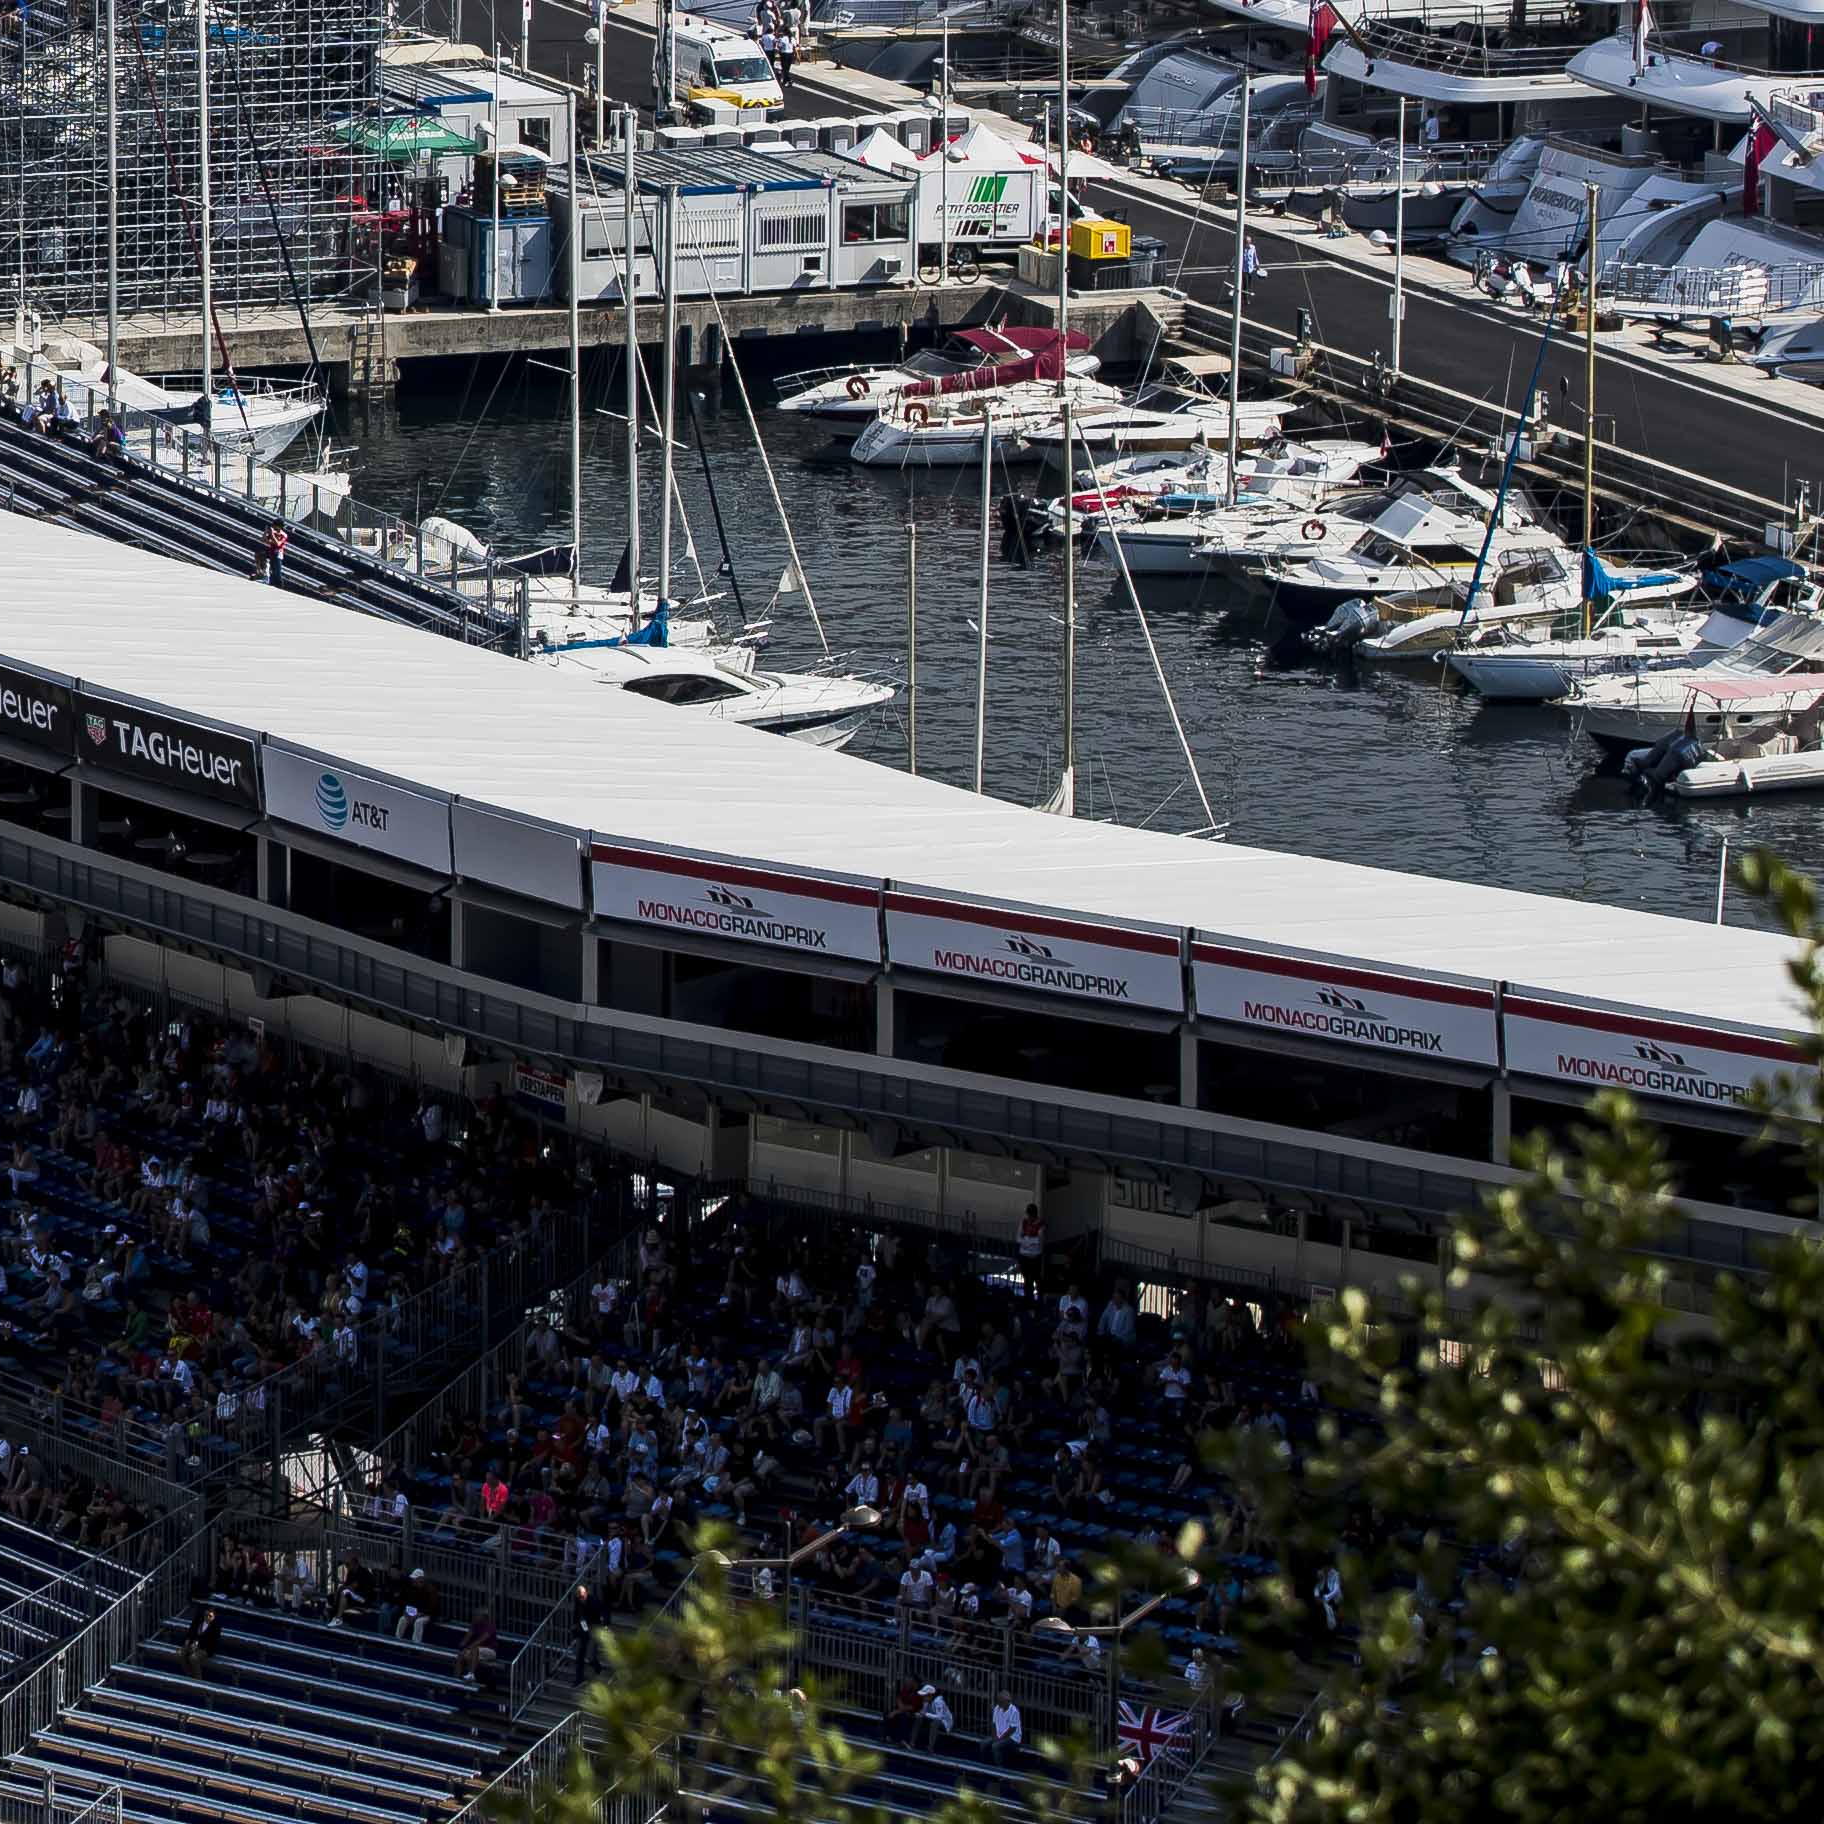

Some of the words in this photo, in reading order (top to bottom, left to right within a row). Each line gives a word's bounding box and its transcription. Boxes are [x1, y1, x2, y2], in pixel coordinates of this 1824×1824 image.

[965, 204, 1020, 217] FORESTIER
[351, 801, 389, 832] AT&T
[518, 1074, 565, 1106] VERSTAPPEN
